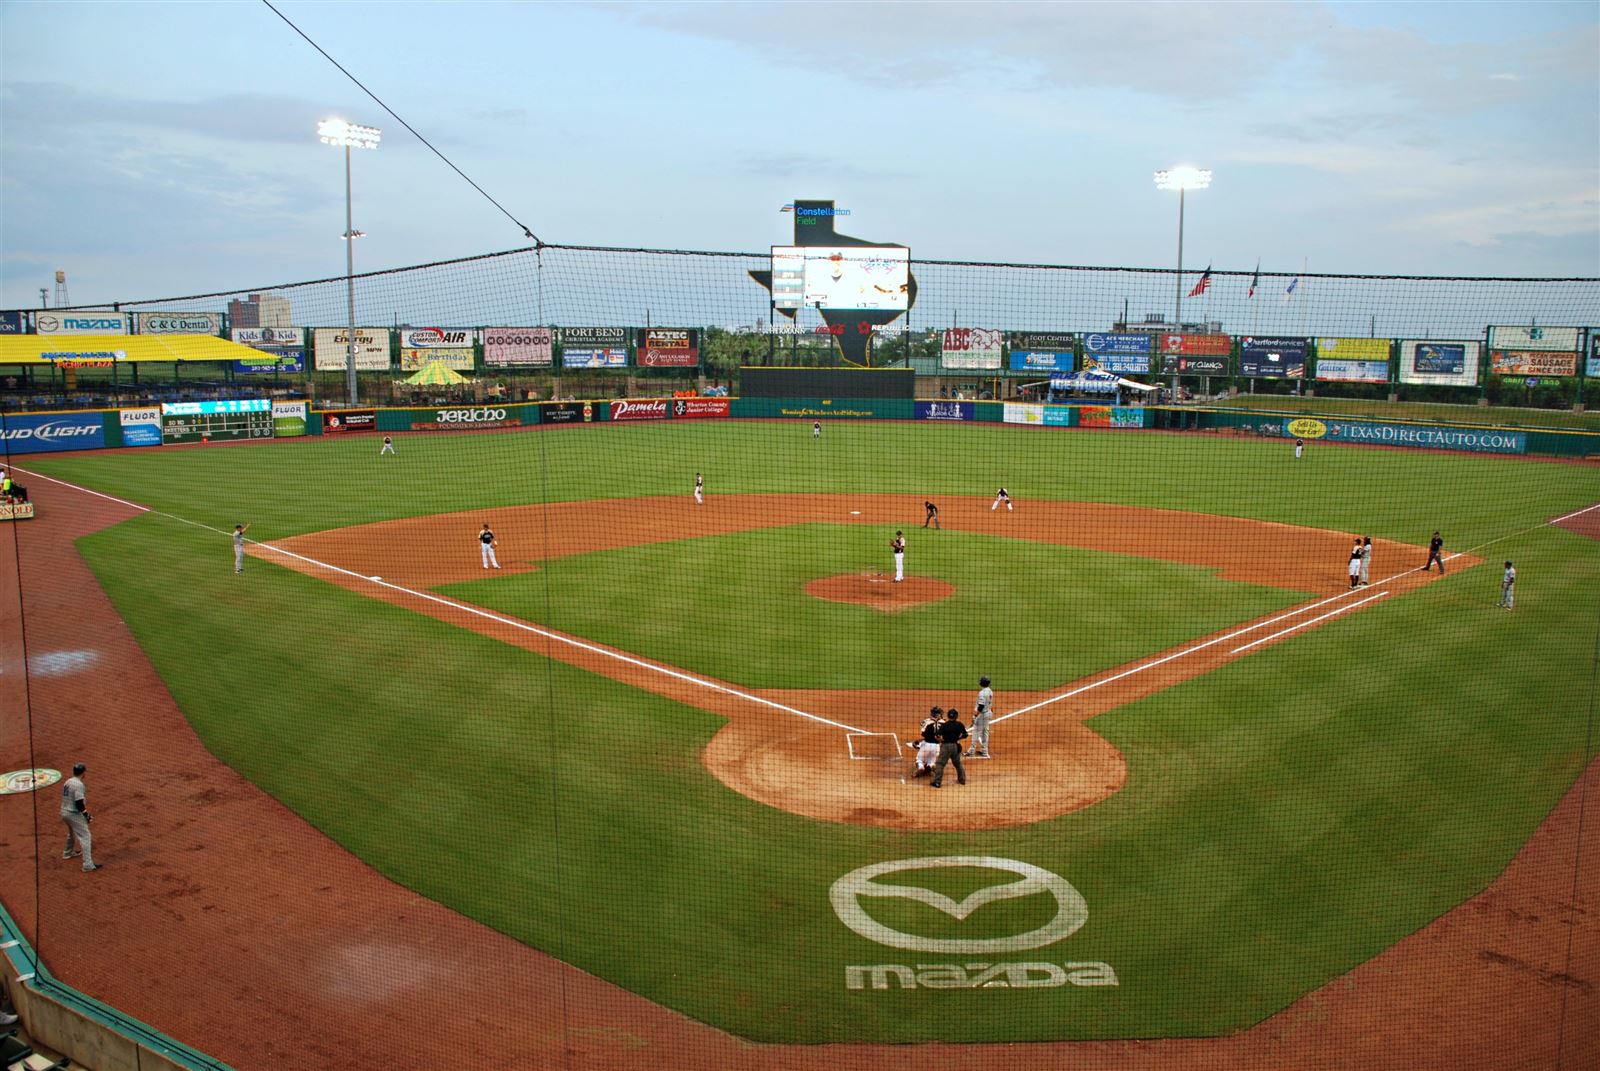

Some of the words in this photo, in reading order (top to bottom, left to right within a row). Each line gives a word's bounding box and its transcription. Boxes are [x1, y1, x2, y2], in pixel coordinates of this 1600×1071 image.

[797, 206, 851, 216] Constellation
[797, 217, 816, 226] Field
[64, 318, 122, 330] mazda
[151, 320, 157, 329] C
[160, 320, 170, 330] &
[172, 320, 178, 329] C
[180, 319, 209, 331] Dental
[239, 331, 258, 340] Kids
[278, 331, 297, 340] Kids
[566, 328, 593, 336] FORT
[596, 328, 625, 336] BEND
[648, 331, 688, 339] AZTEC
[334, 336, 374, 345] Enrgy
[442, 333, 467, 344] AIR
[943, 328, 970, 351] ABC
[1530, 359, 1573, 367] SAUSAGE
[1527, 367, 1552, 375] SINCE
[275, 406, 302, 414] FLUOR
[611, 401, 667, 420] Pamela
[124, 412, 156, 421] FLUOR
[0, 429, 32, 439] UD
[42, 425, 102, 437] LIGHT
[845, 961, 1120, 989] mazda
